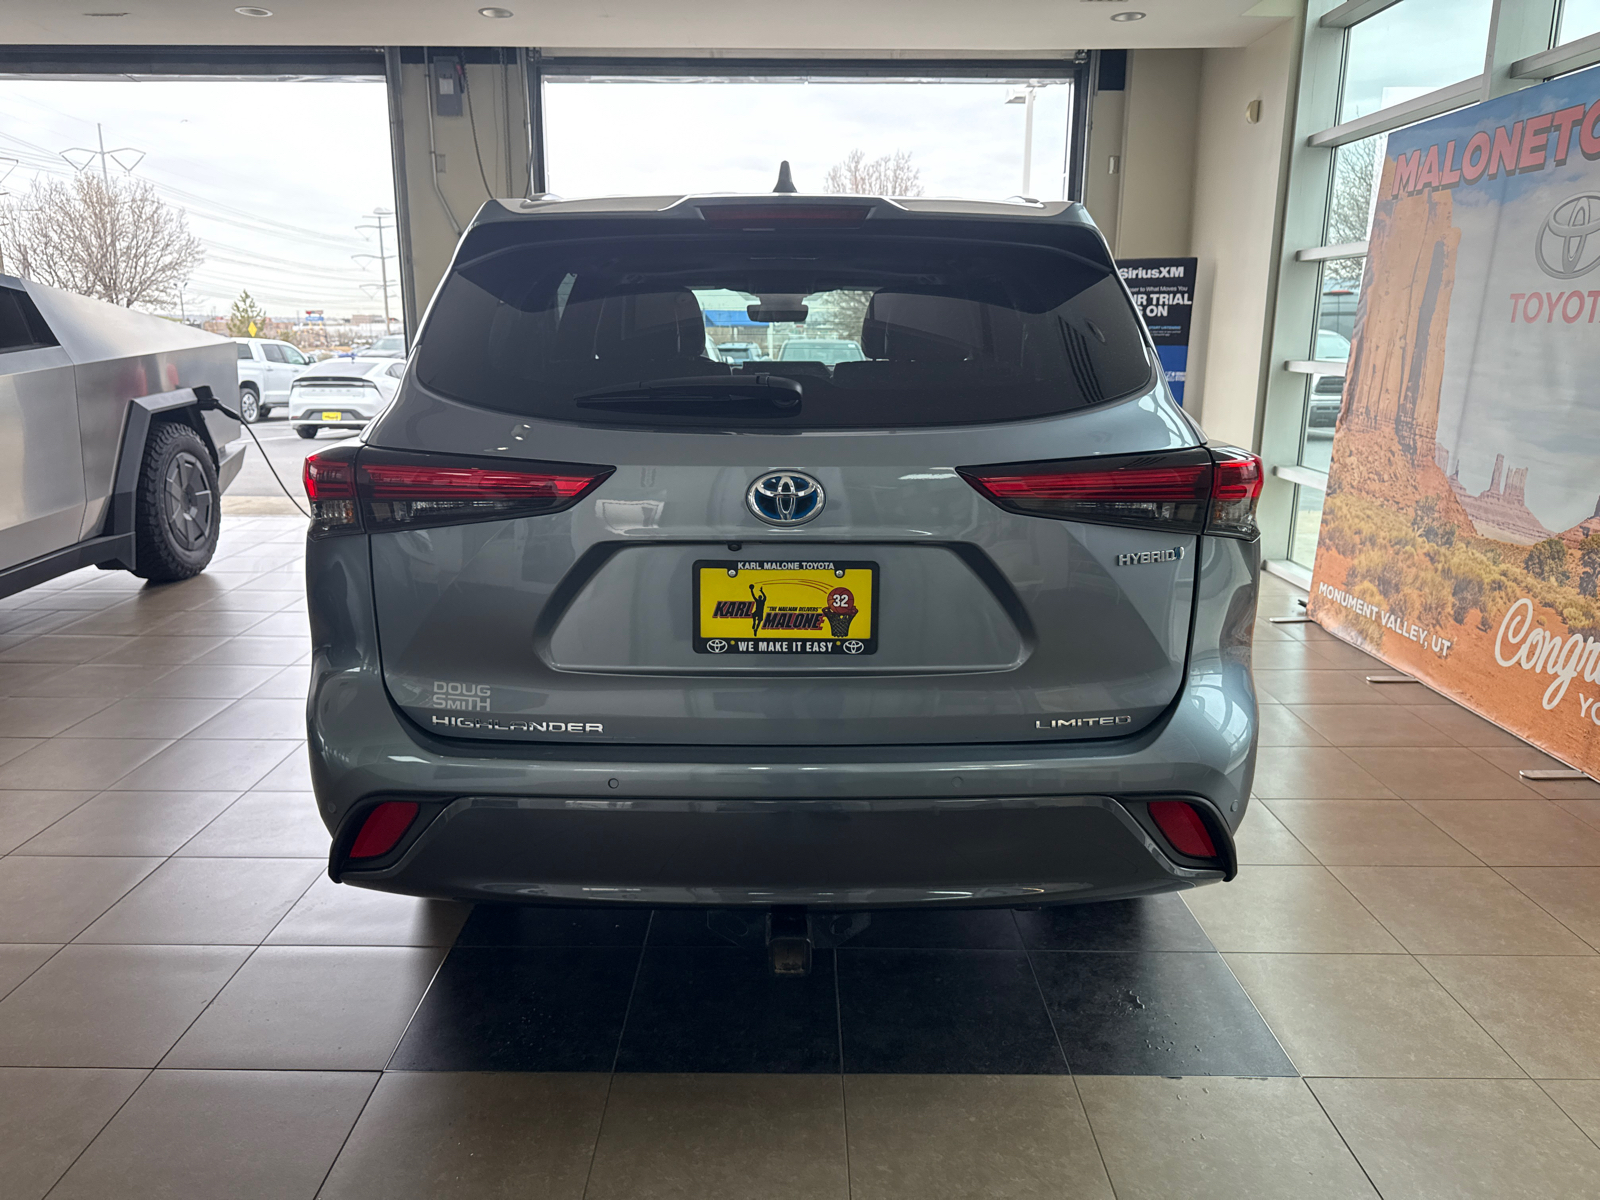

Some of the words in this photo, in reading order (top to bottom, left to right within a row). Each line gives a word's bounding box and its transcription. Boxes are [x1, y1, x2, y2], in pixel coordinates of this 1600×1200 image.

[1119, 266, 1184, 279] SiriusXM
[1150, 293, 1192, 305] TRIAL
[1146, 305, 1168, 317] ON
[1509, 290, 1600, 324] TOYOT
[1117, 549, 1176, 566] HYBRID
[737, 562, 761, 570] KARL
[763, 562, 800, 570] MALONE
[802, 562, 835, 570] TOYOTA
[833, 594, 849, 607] 32
[712, 601, 755, 618] KARL
[761, 612, 824, 631] MALONE
[1318, 581, 1379, 621] MONUMENT
[1381, 609, 1429, 650] VALLEY,
[1431, 634, 1451, 656] UT
[738, 642, 754, 652] WE
[758, 642, 788, 651] MAKE
[792, 642, 802, 651] IT
[806, 642, 833, 652] EASY
[433, 681, 491, 697] DOUG
[432, 715, 604, 734] HIGHLANDER
[1035, 715, 1132, 729] LIMITED
